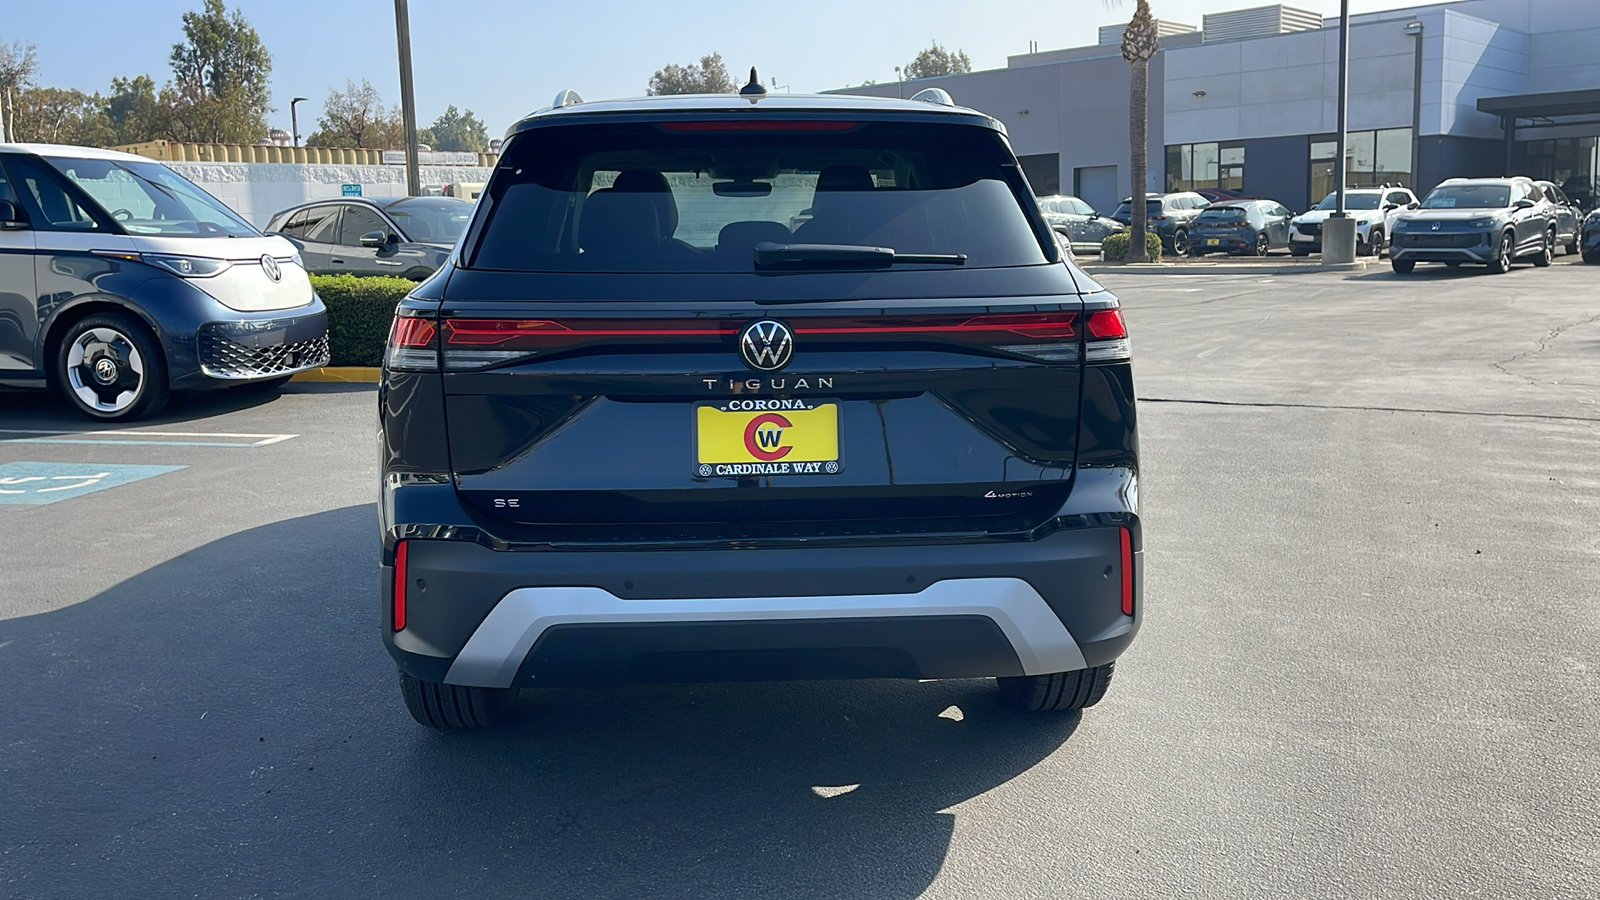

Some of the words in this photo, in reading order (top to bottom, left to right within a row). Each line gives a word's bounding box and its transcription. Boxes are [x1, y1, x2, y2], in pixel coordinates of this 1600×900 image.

[741, 320, 793, 371] VW
[702, 377, 834, 390] TIGUAN
[728, 399, 806, 411] CORONA
[715, 462, 790, 475] CARDINALE
[792, 462, 822, 474] WAY
[984, 490, 1034, 499] 4MOTION
[493, 498, 520, 508] SE
